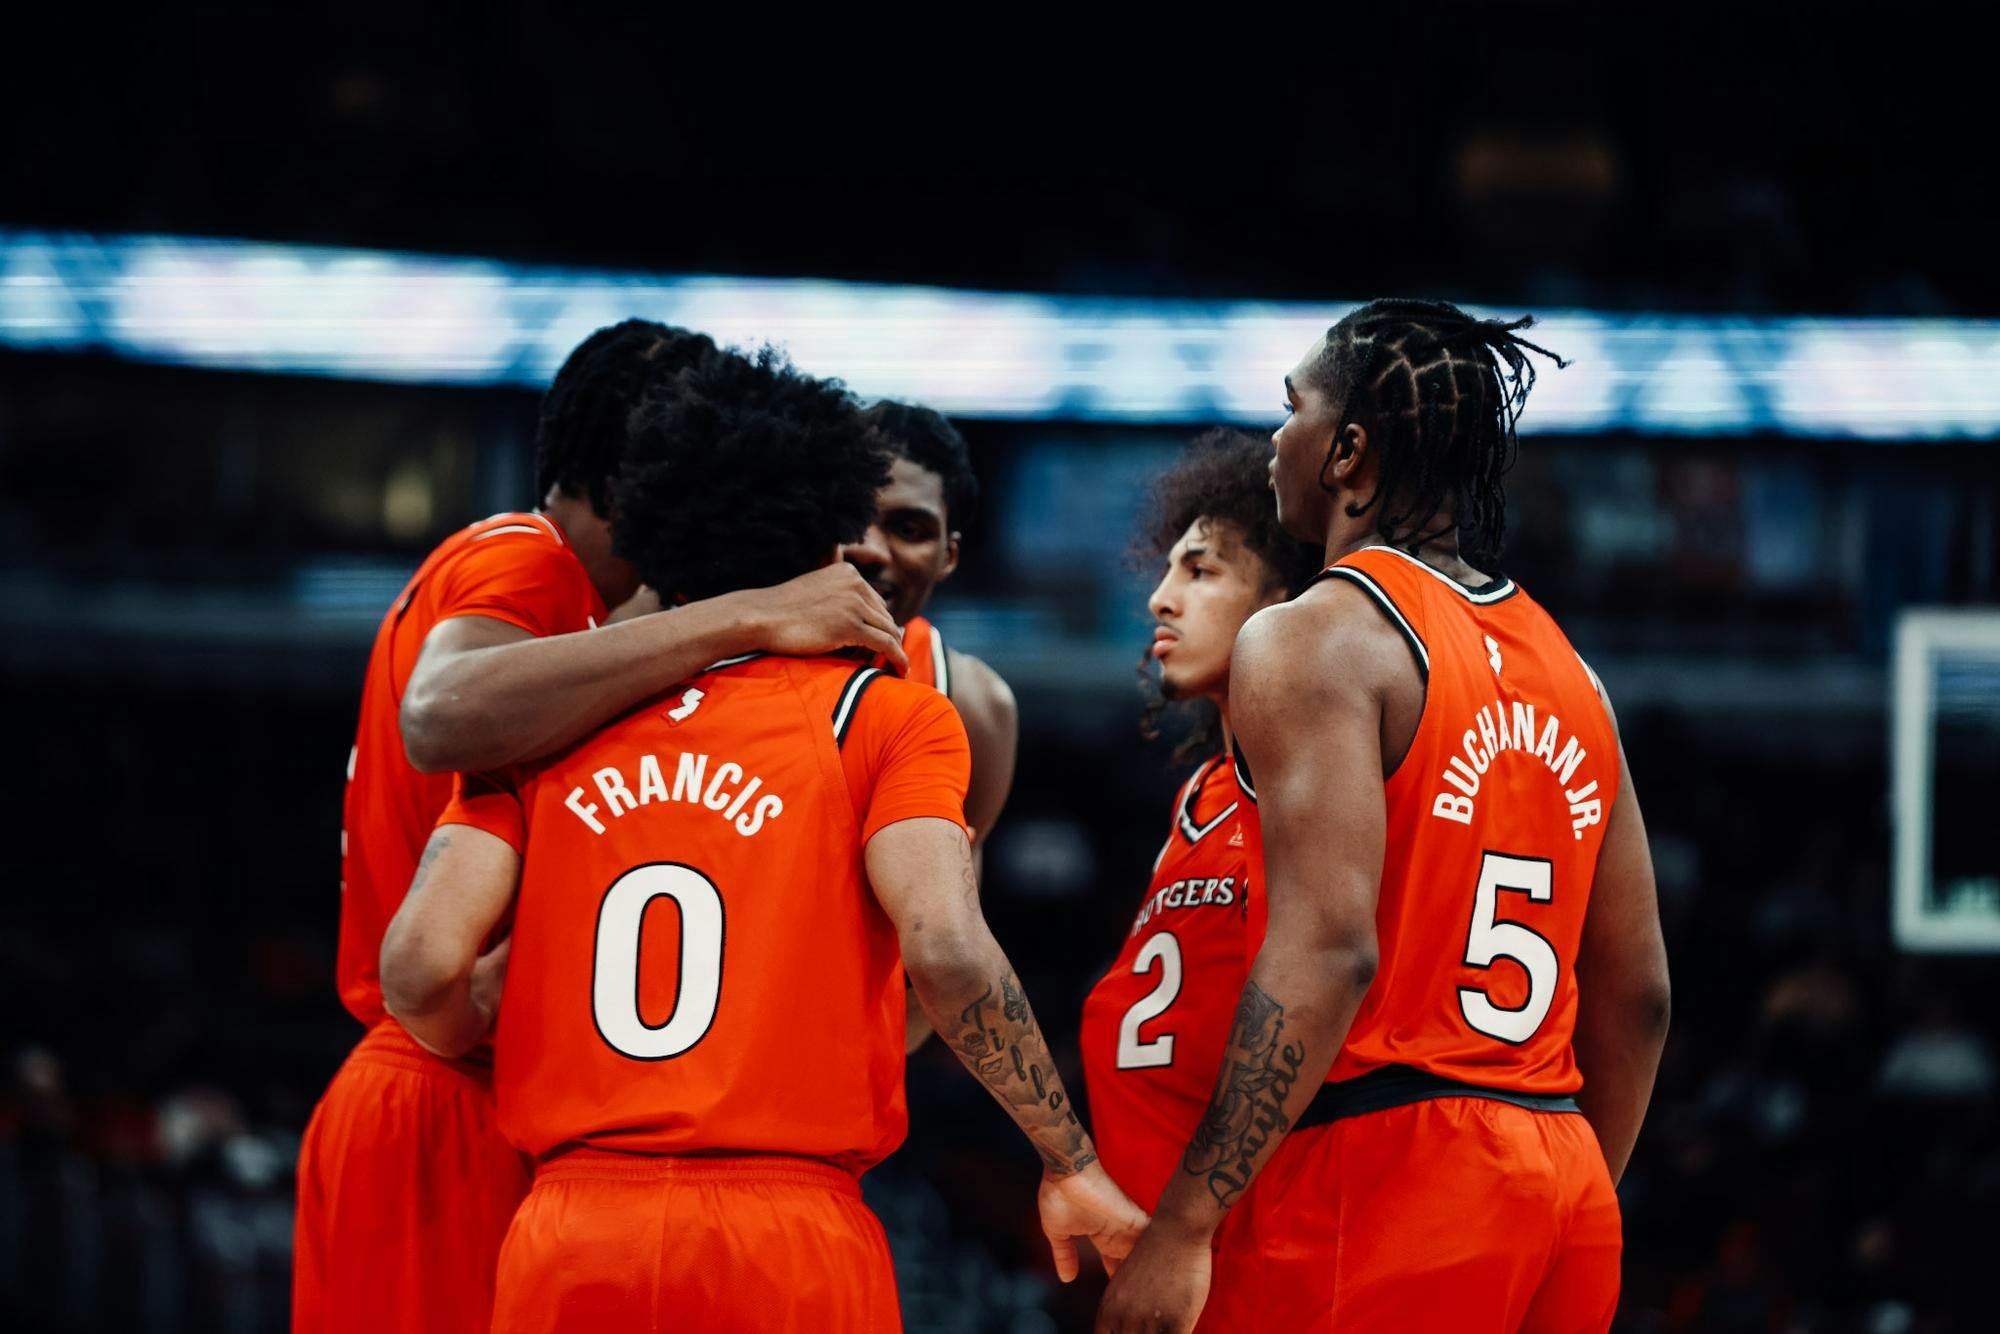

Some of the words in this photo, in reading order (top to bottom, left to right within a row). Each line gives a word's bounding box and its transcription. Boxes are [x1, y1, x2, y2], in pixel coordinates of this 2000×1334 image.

[564, 751, 784, 837] FRANCIS
[1432, 700, 1586, 825] BUCHANAN
[1564, 780, 1602, 840] JR.
[591, 861, 726, 1062] 0
[1115, 930, 1183, 1070] 2
[1456, 849, 1560, 1046] 5
